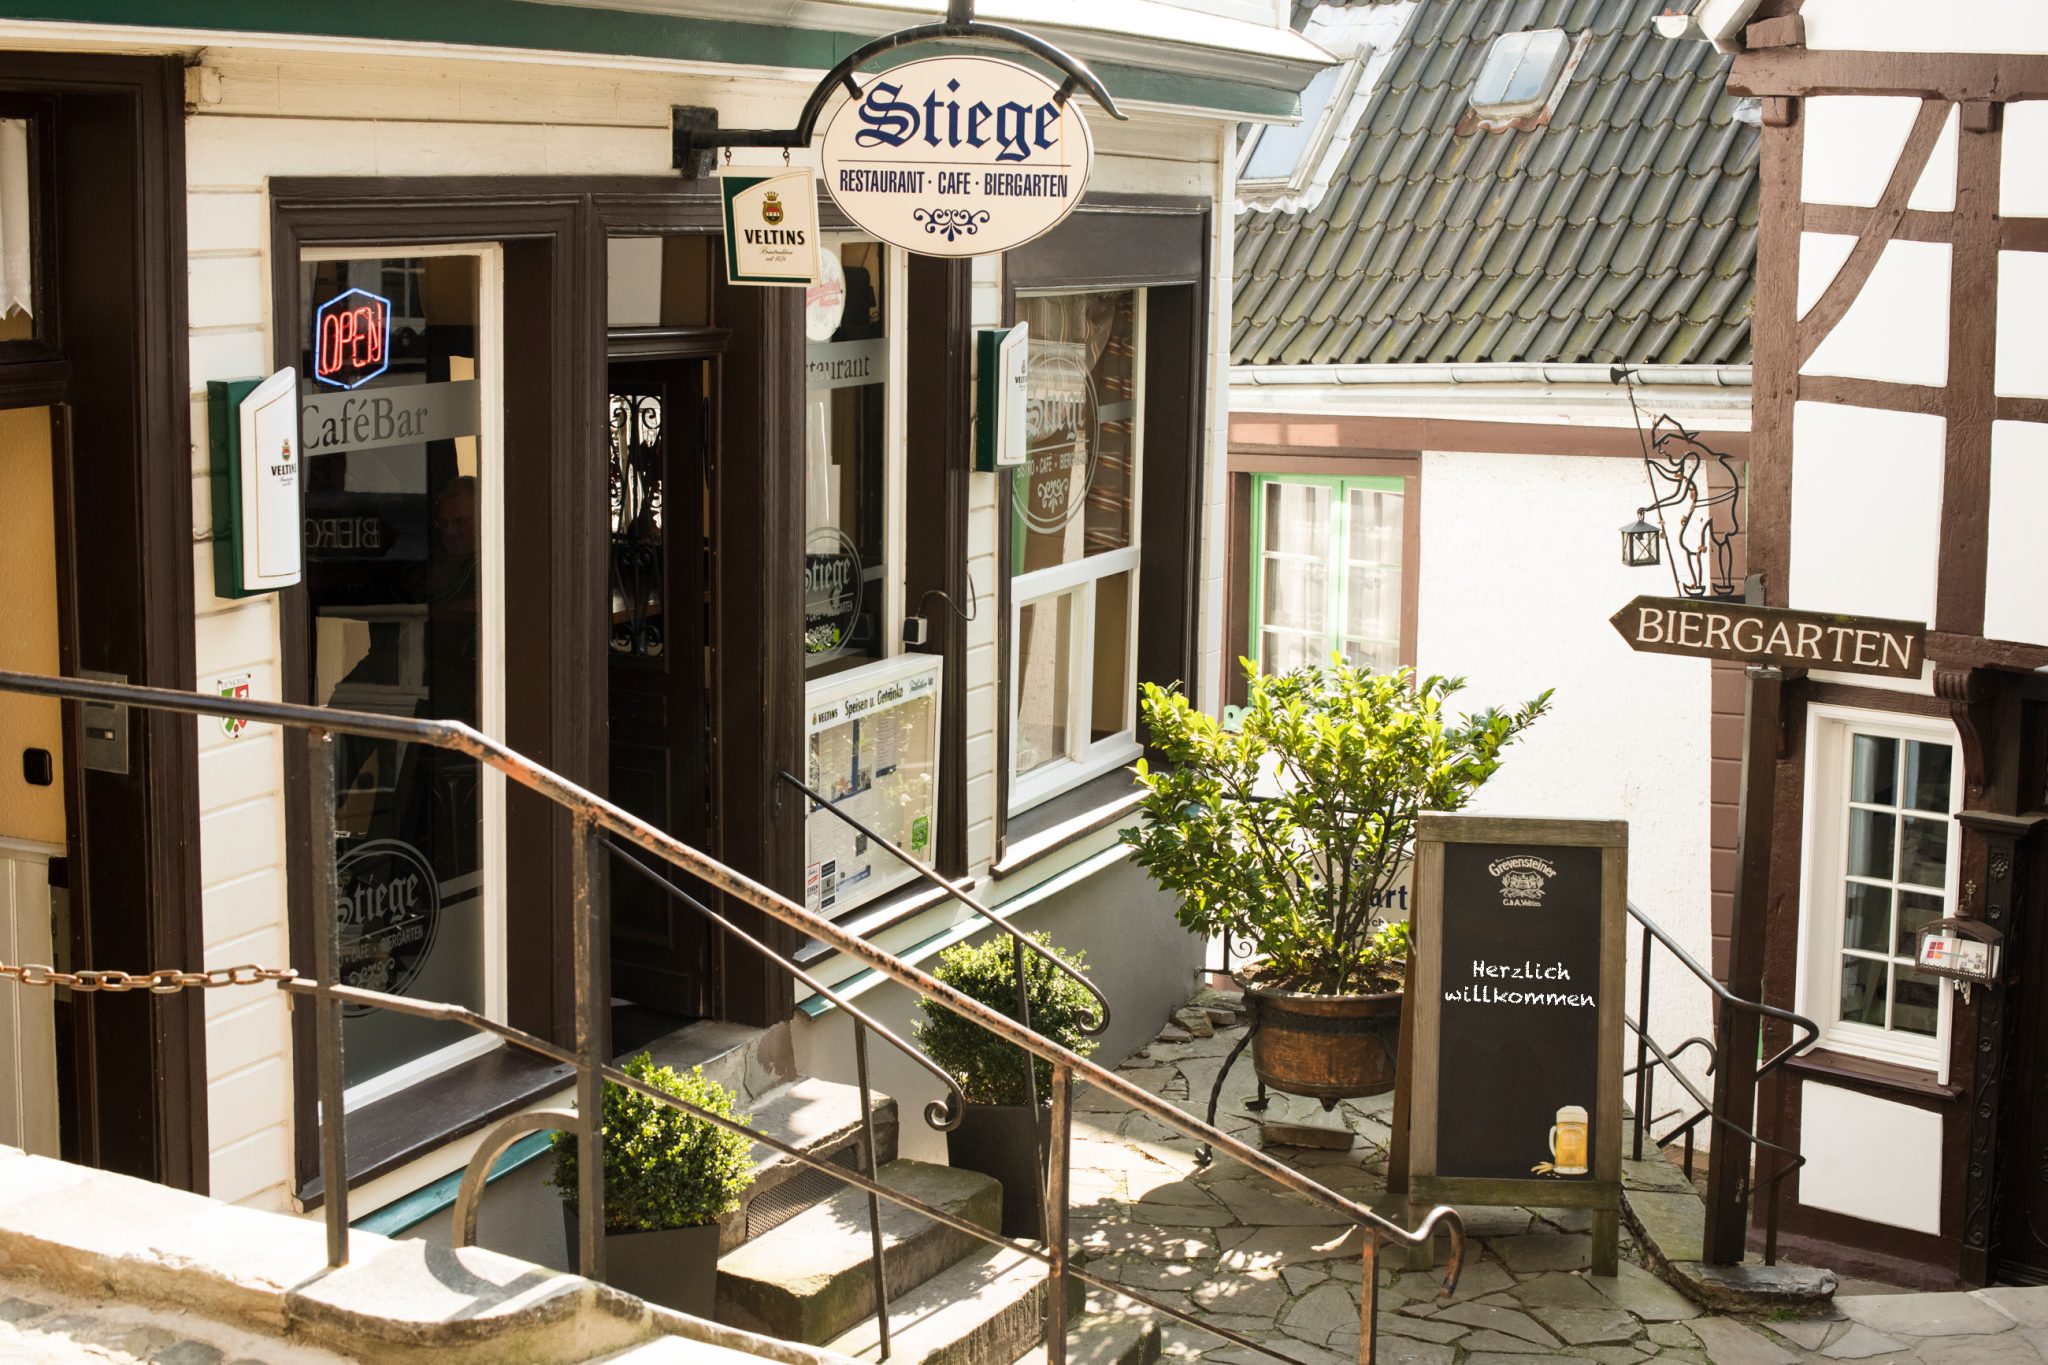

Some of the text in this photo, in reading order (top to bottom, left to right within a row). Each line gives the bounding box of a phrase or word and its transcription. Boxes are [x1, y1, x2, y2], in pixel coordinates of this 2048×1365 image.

[855, 78, 1061, 162] Stiege
[840, 169, 1068, 198] RESTAURANT CAFE BIERGARTEN
[744, 229, 805, 245] VELTINS
[320, 302, 382, 375] OPEN
[303, 397, 429, 449] CaféBar
[1636, 607, 1915, 671] BIERGARTEN
[818, 708, 839, 724] VELTINS
[844, 699, 869, 718] Speisen
[1488, 858, 1557, 878] Grevensteiner
[1473, 960, 1571, 980] Herzlich
[1444, 984, 1596, 1008] willkommen
